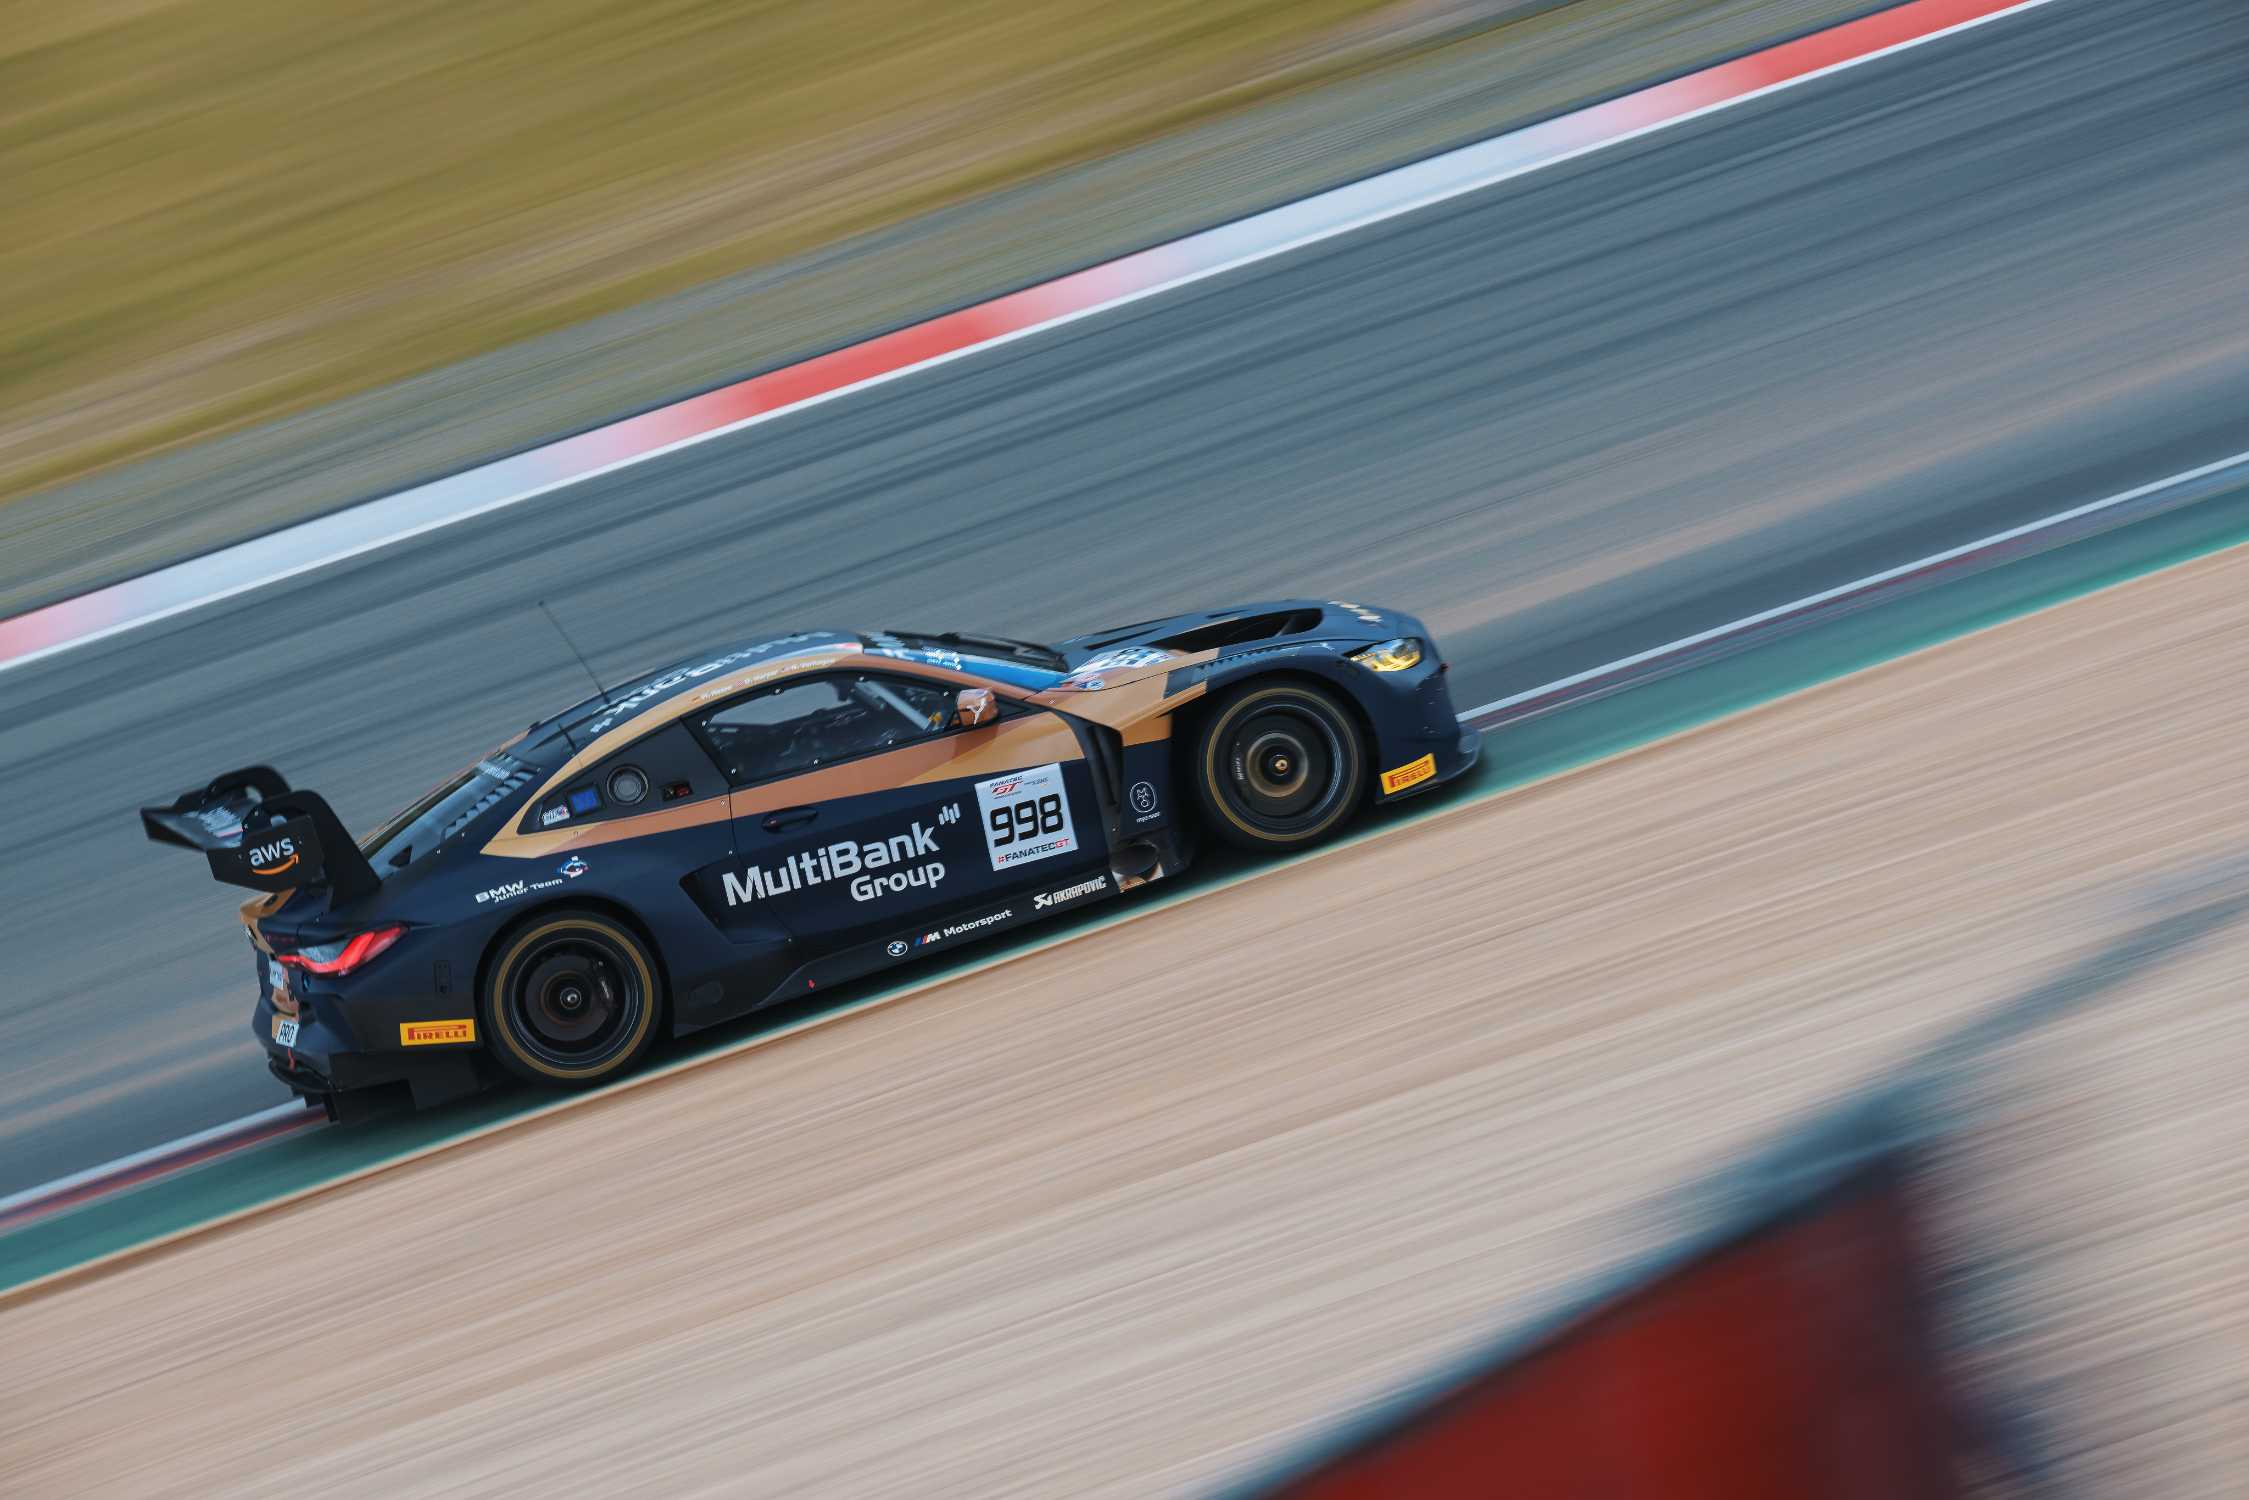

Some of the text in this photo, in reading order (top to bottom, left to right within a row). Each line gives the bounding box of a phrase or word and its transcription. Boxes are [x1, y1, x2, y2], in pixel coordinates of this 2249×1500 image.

[1387, 760, 1431, 788] PIRELLI
[989, 793, 1064, 848] 998
[249, 838, 295, 867] aws
[722, 822, 941, 907] MultiBank
[997, 838, 1070, 864] #FANATECGT
[475, 880, 524, 904] BMW
[494, 879, 563, 904] Junior Team
[850, 862, 945, 902] Group
[943, 909, 1013, 937] Motorsport
[279, 1022, 296, 1044] PRO
[408, 1024, 467, 1041] PIRELLI
